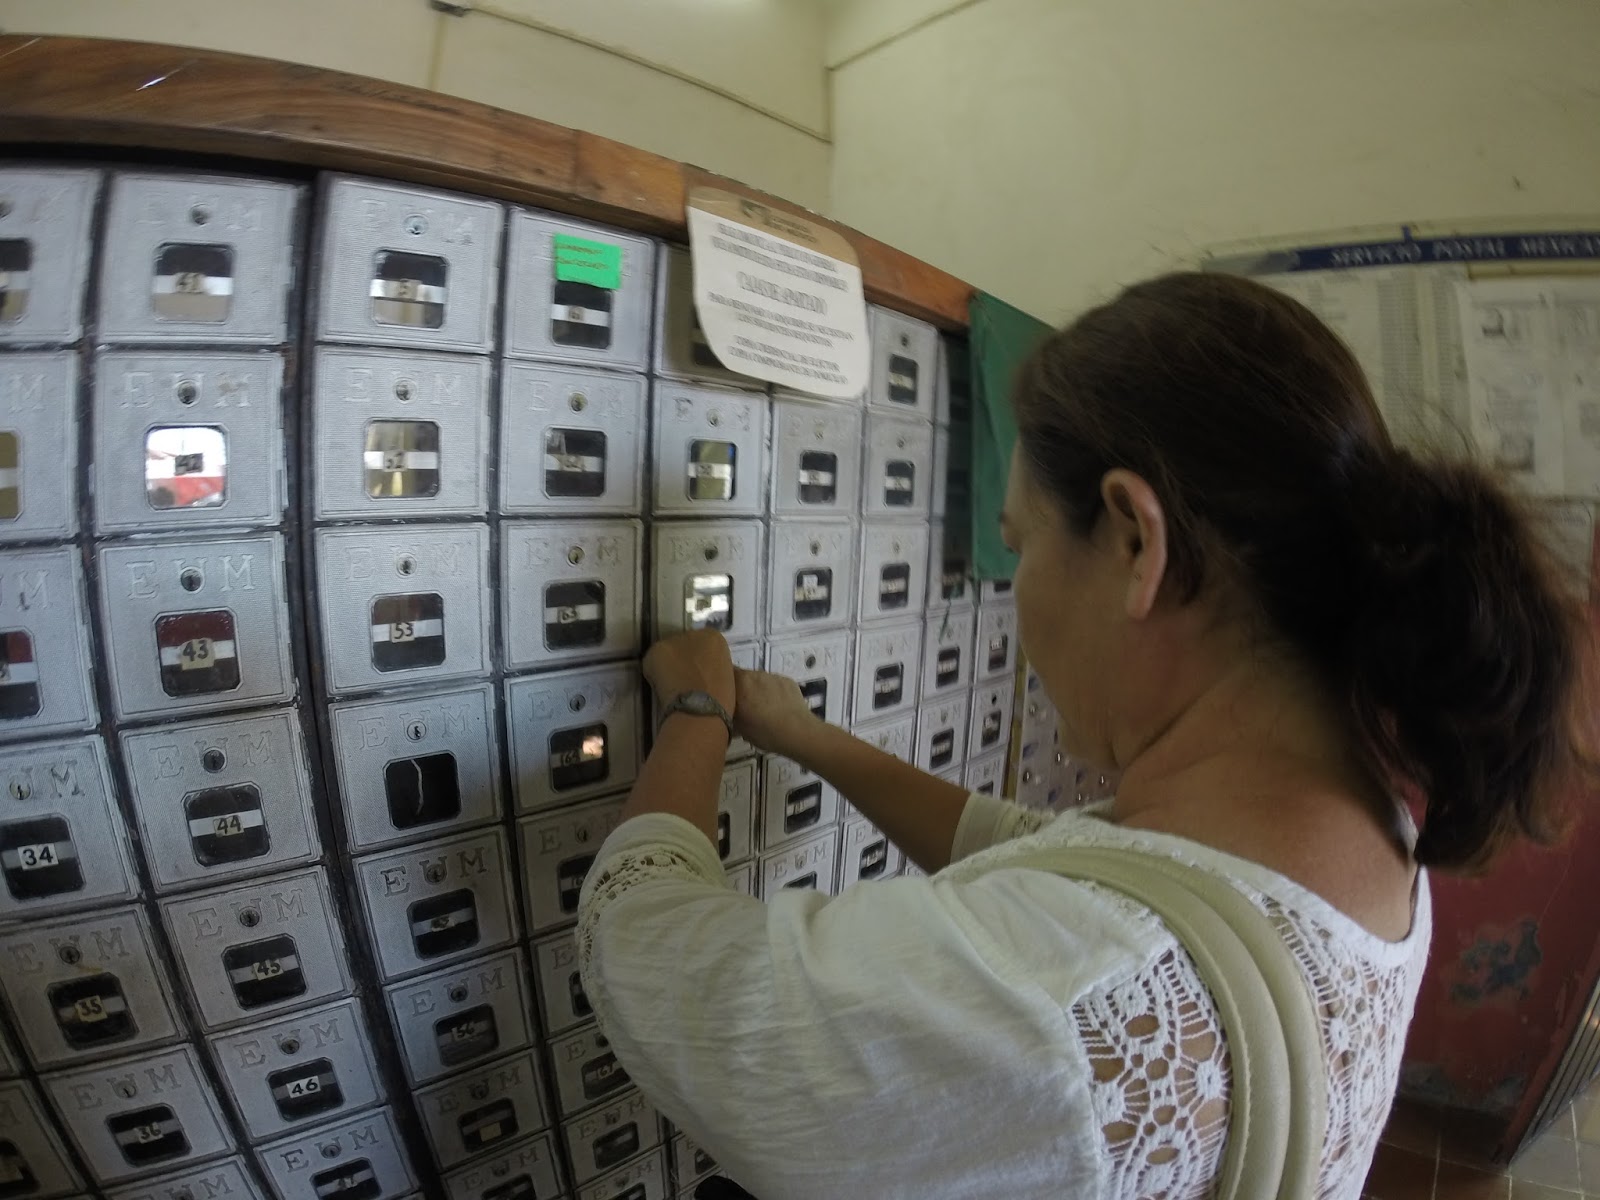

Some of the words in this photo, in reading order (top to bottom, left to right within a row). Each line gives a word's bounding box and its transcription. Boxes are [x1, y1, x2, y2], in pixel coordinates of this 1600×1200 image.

[393, 621, 415, 640] 53
[182, 640, 209, 662] 43
[216, 816, 243, 835] 44
[21, 845, 54, 867] 34
[256, 959, 281, 976] 45
[80, 999, 103, 1017] 35
[291, 1078, 319, 1096] 46
[139, 1123, 163, 1141] 36
